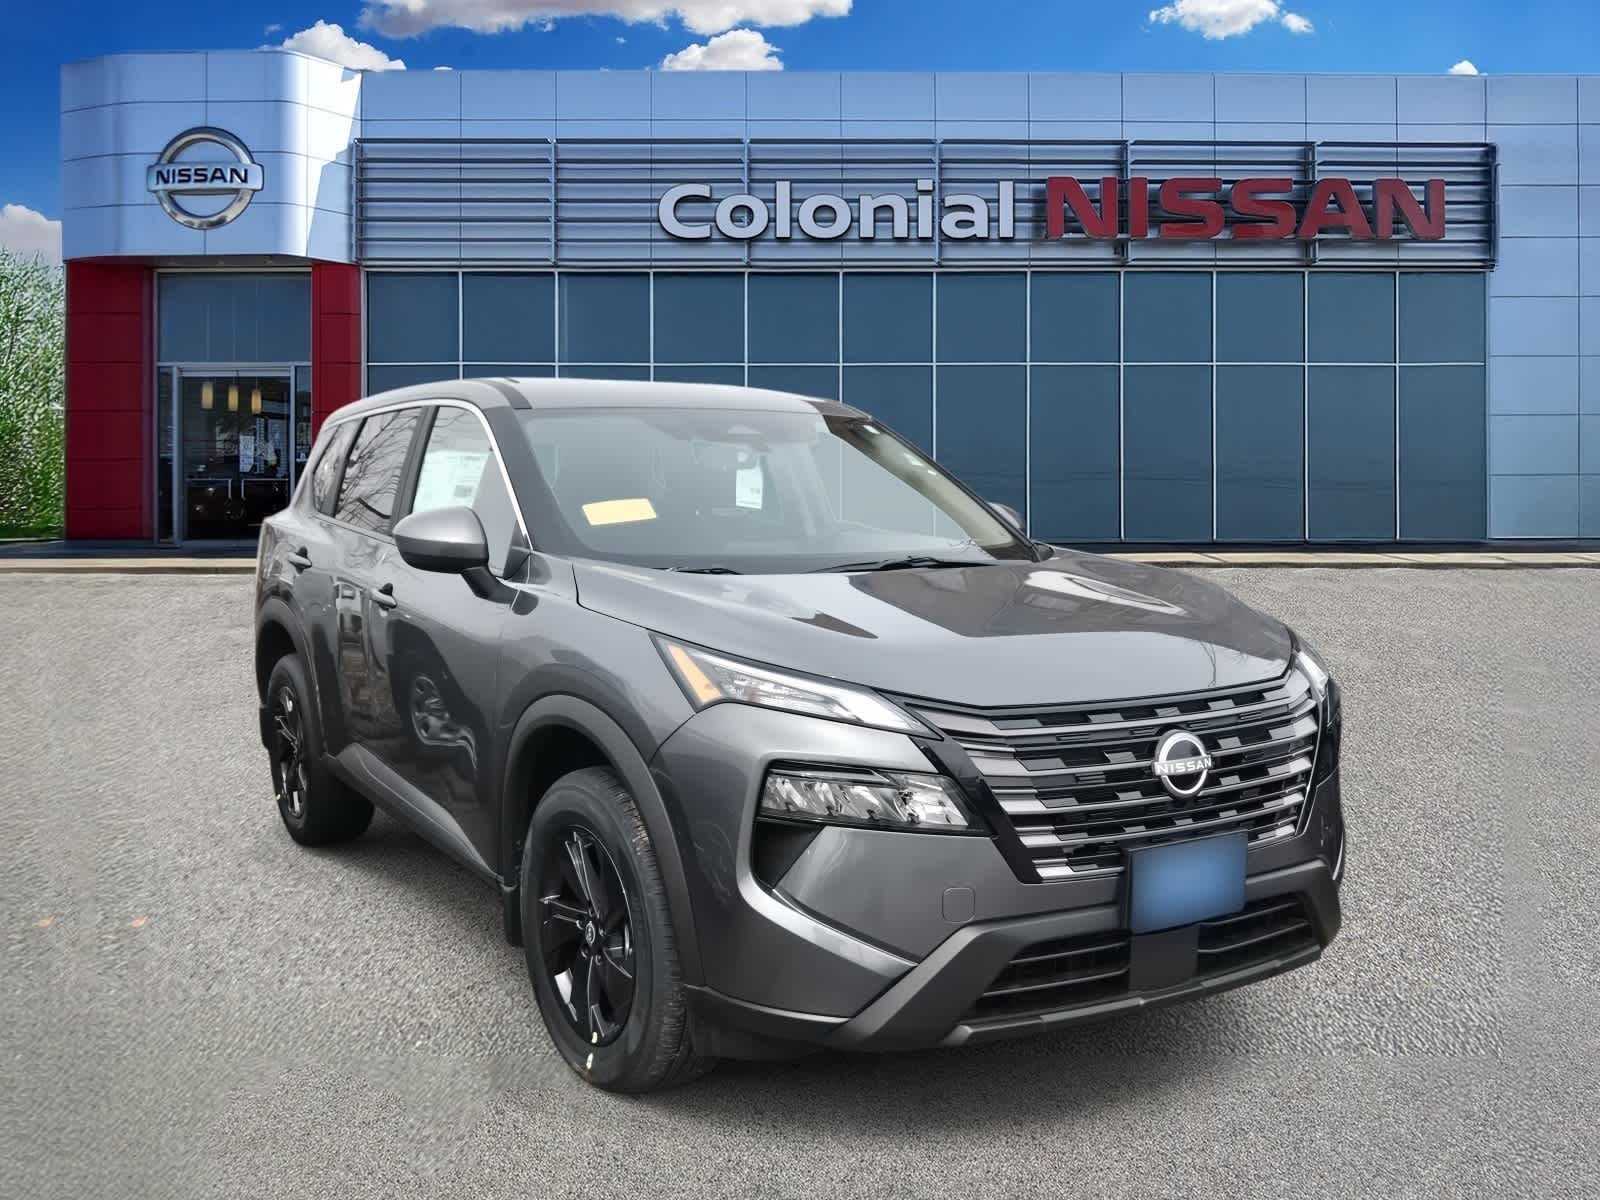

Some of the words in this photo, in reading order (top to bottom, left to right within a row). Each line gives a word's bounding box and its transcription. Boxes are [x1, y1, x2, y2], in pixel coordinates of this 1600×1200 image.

[156, 167, 249, 185] NISSAN
[657, 178, 1015, 240] Colonial
[1046, 176, 1446, 240] NISSAN
[1156, 756, 1212, 775] NISSAN
